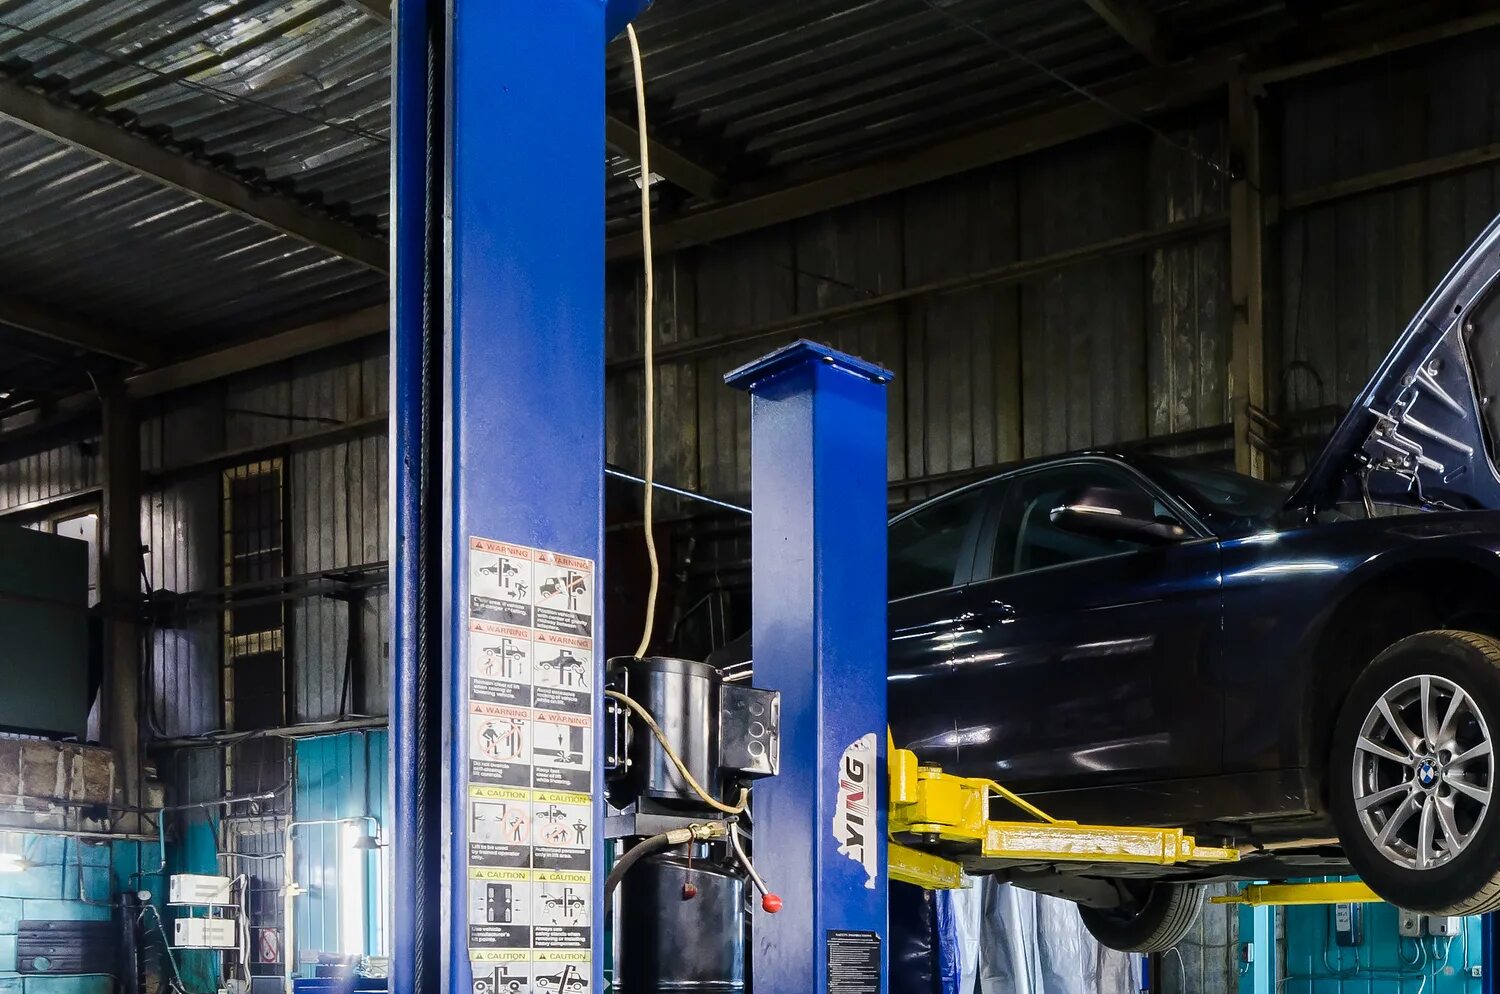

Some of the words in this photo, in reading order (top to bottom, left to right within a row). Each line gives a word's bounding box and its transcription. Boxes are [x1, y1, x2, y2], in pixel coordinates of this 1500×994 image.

[487, 543, 528, 557] WARNING
[553, 554, 588, 569] ARNING
[487, 626, 528, 638] WARNING
[549, 635, 588, 648] WARNING
[486, 706, 528, 718] WARNING
[548, 714, 588, 726] WARNING
[487, 790, 526, 799] CAUTION
[550, 795, 586, 804] CAUTION
[487, 871, 526, 879] CAUTION
